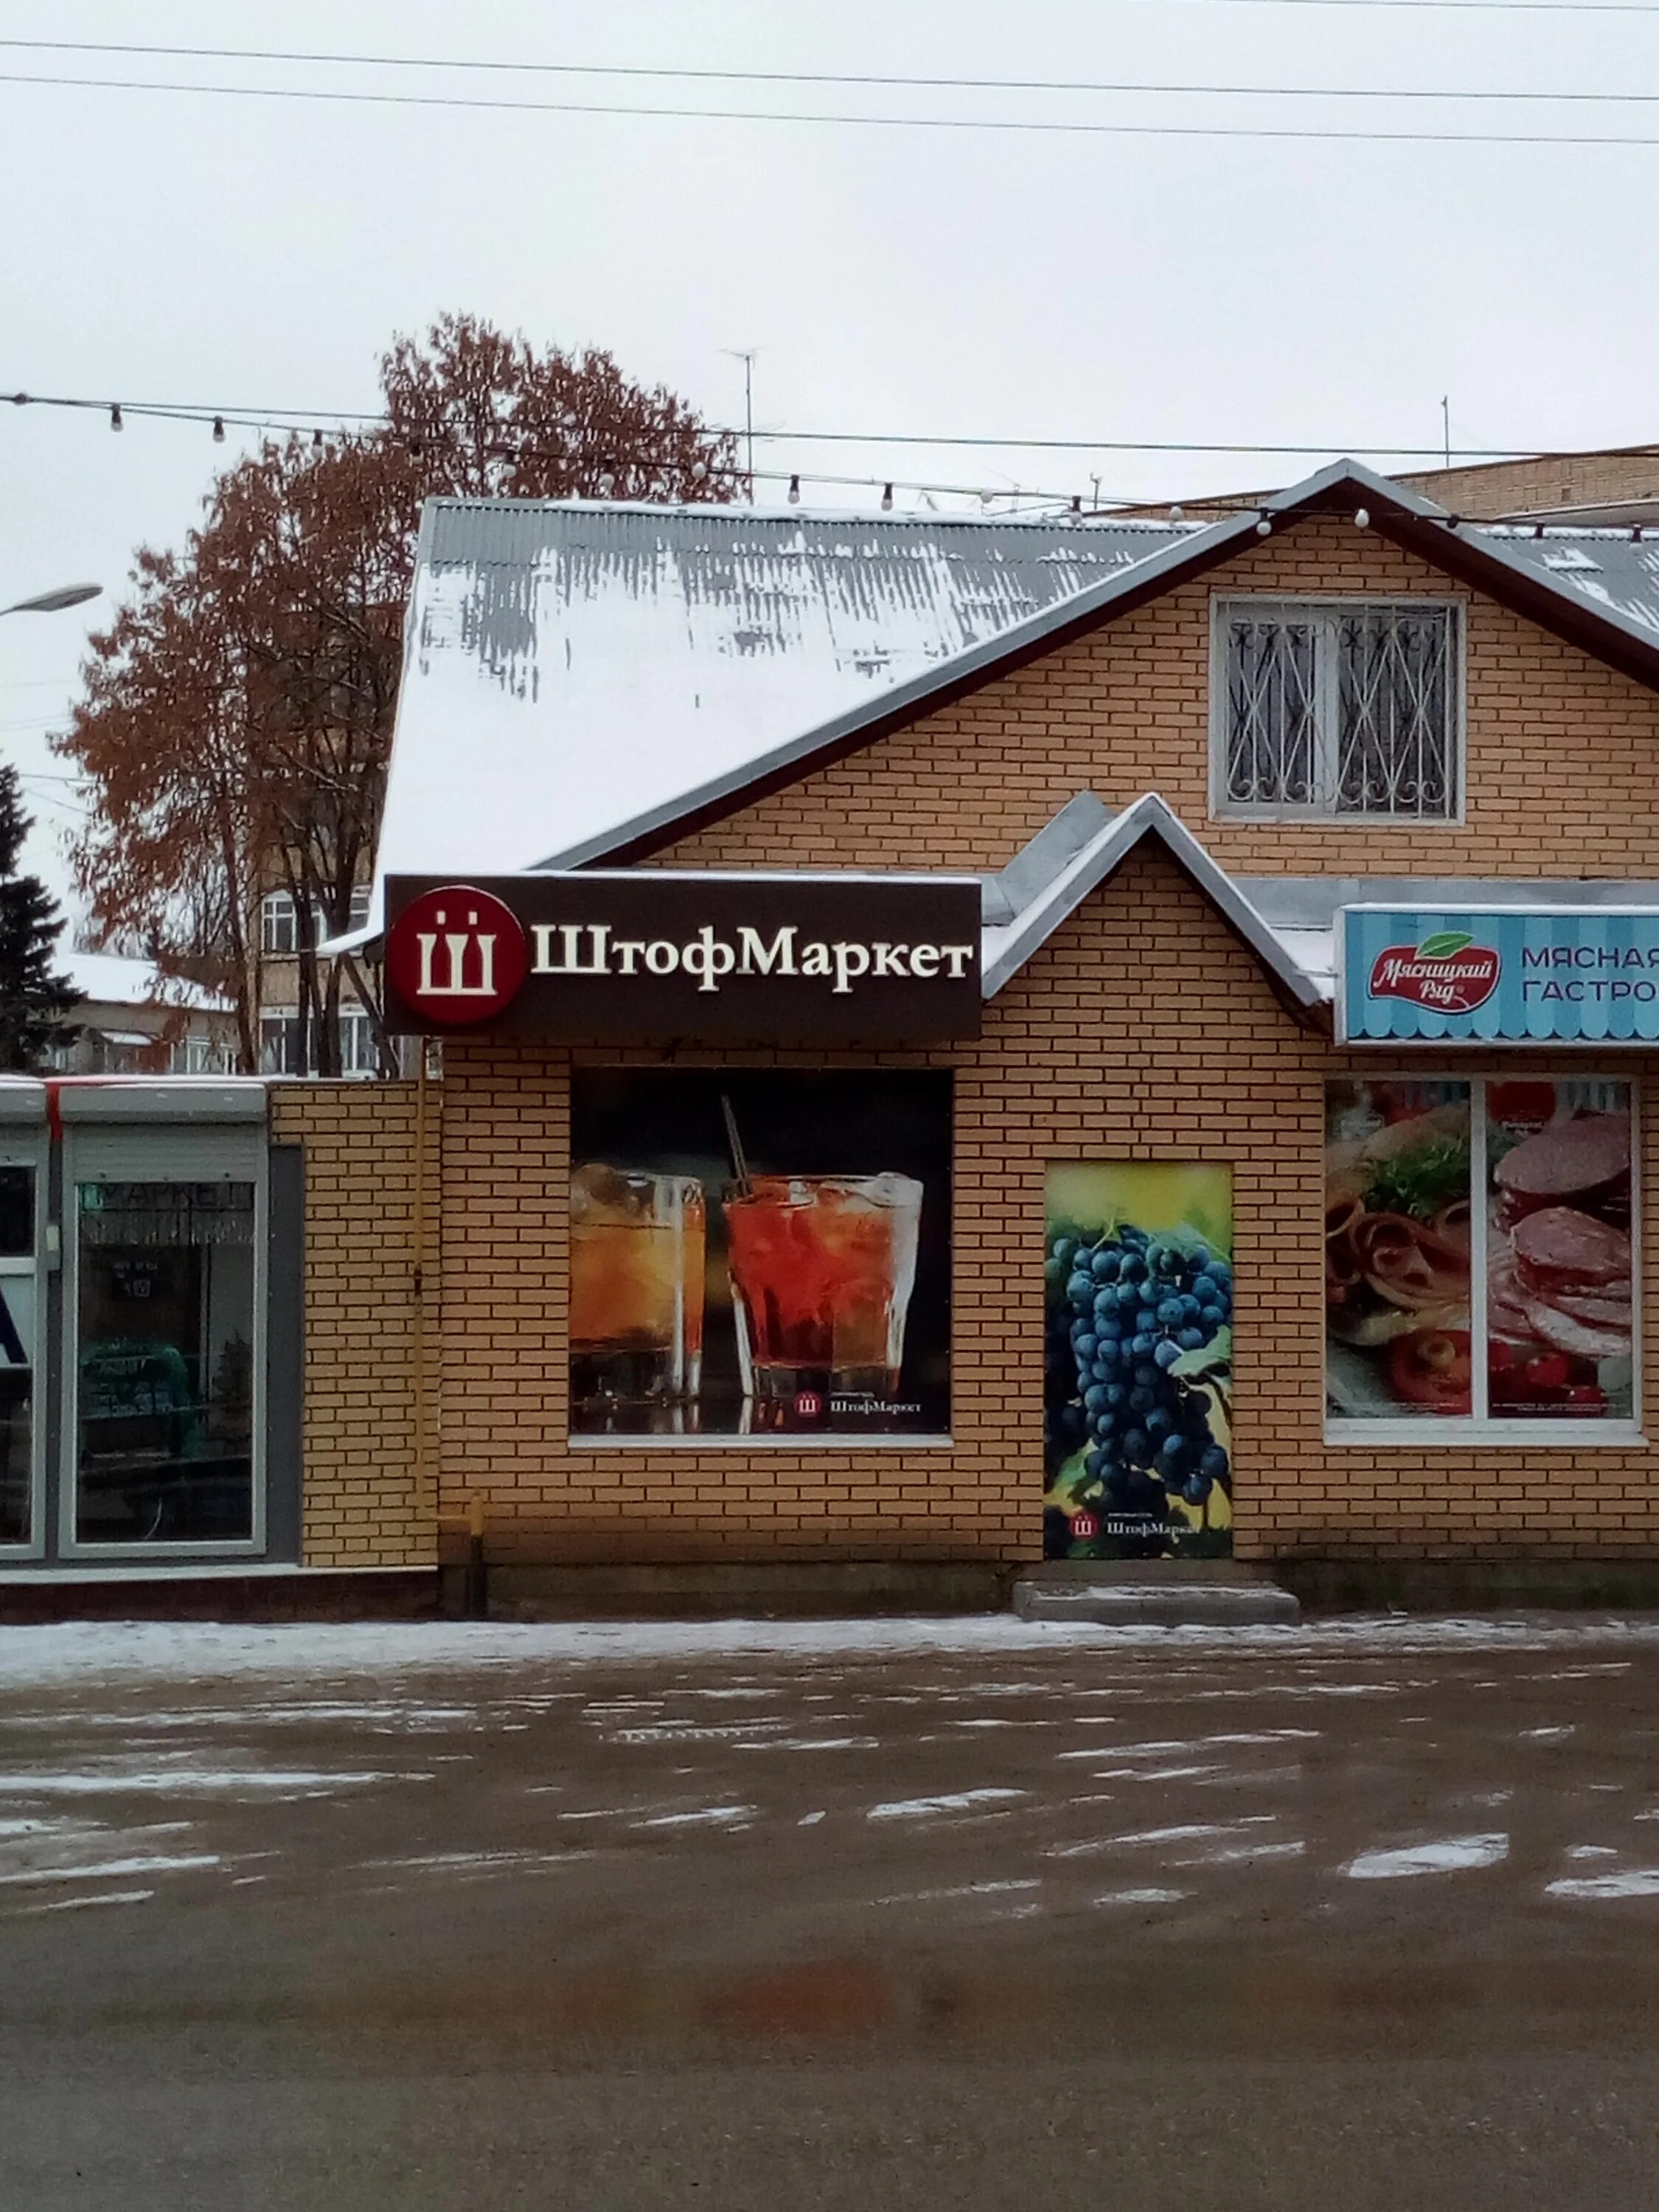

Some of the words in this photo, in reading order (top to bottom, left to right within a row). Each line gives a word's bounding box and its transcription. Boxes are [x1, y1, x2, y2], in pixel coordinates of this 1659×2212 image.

[530, 924, 973, 992] ШтофМаркет
[1373, 959, 1493, 988] Мясницкий
[1419, 979, 1455, 1005] Ряд
